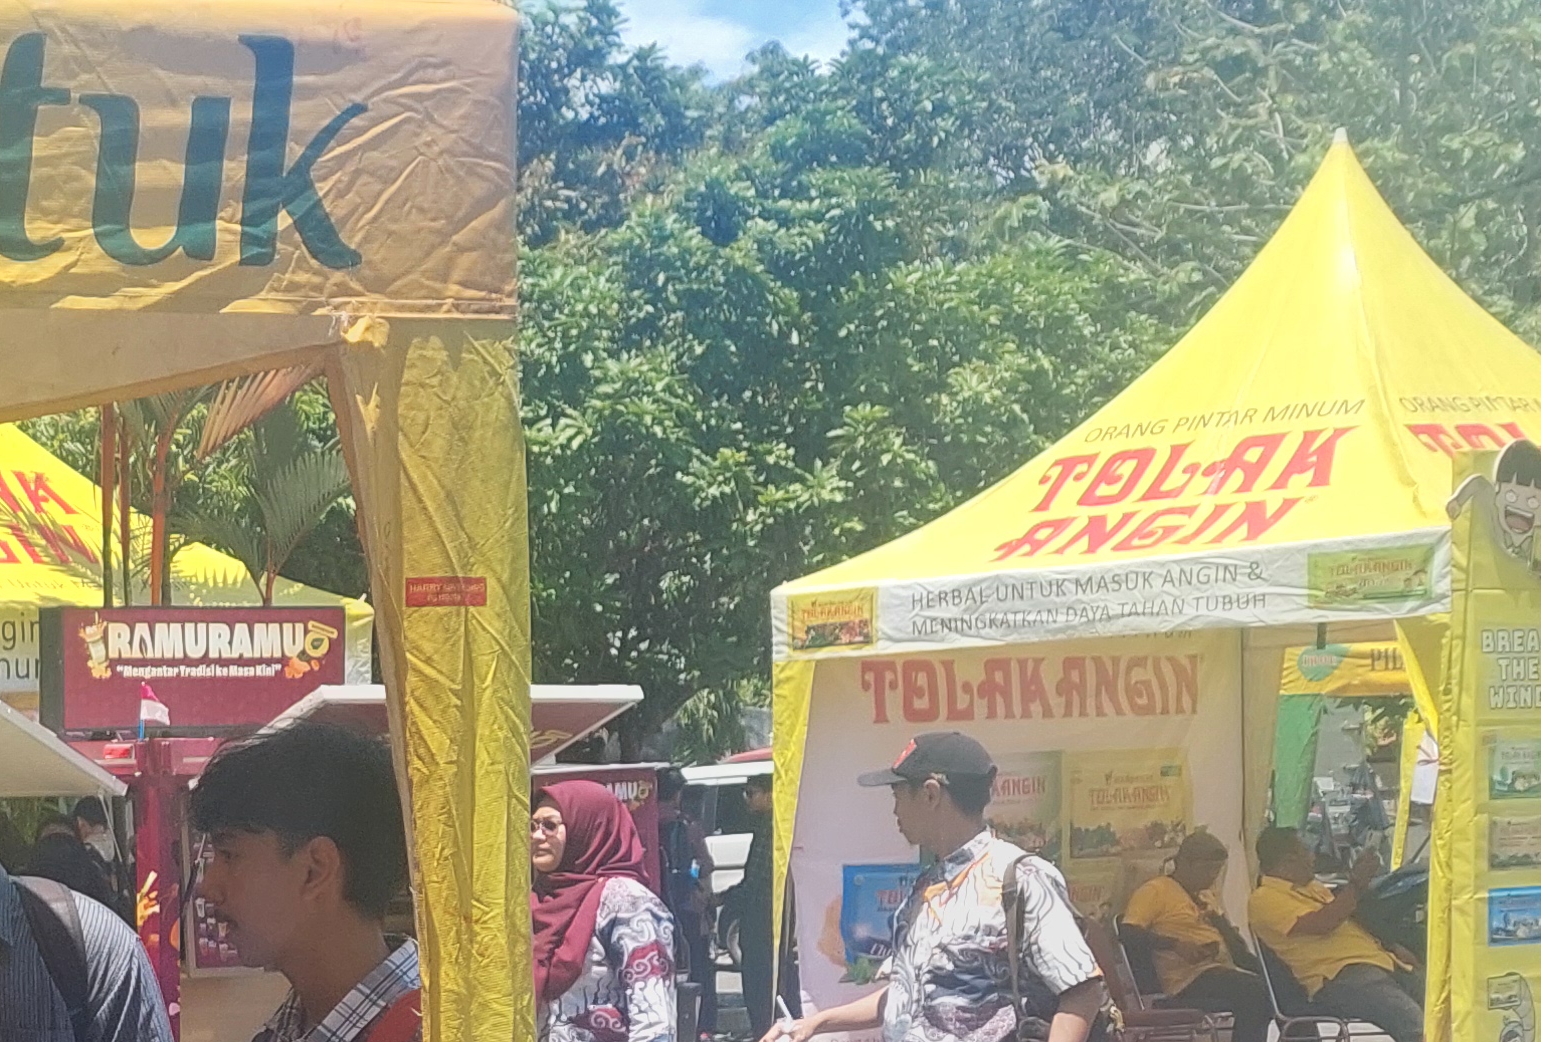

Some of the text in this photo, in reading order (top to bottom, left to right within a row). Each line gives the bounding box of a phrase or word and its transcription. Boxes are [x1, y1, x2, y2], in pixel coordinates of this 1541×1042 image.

[1085, 398, 1366, 444] ORANG PINTAR MINUM
[1398, 396, 1468, 415] ORANG
[1029, 424, 1360, 513] TOLAK
[988, 496, 1306, 562] ANGIN
[911, 561, 1265, 612] HERBAL UNTUK MASUK ANGIN &
[911, 592, 1267, 638] MENINGKATKAN DAYA TAHAN TUBUH
[107, 621, 305, 660] RAMURAMU
[860, 652, 1202, 726] TOLAKANGIN
[1497, 657, 1540, 681] THE
